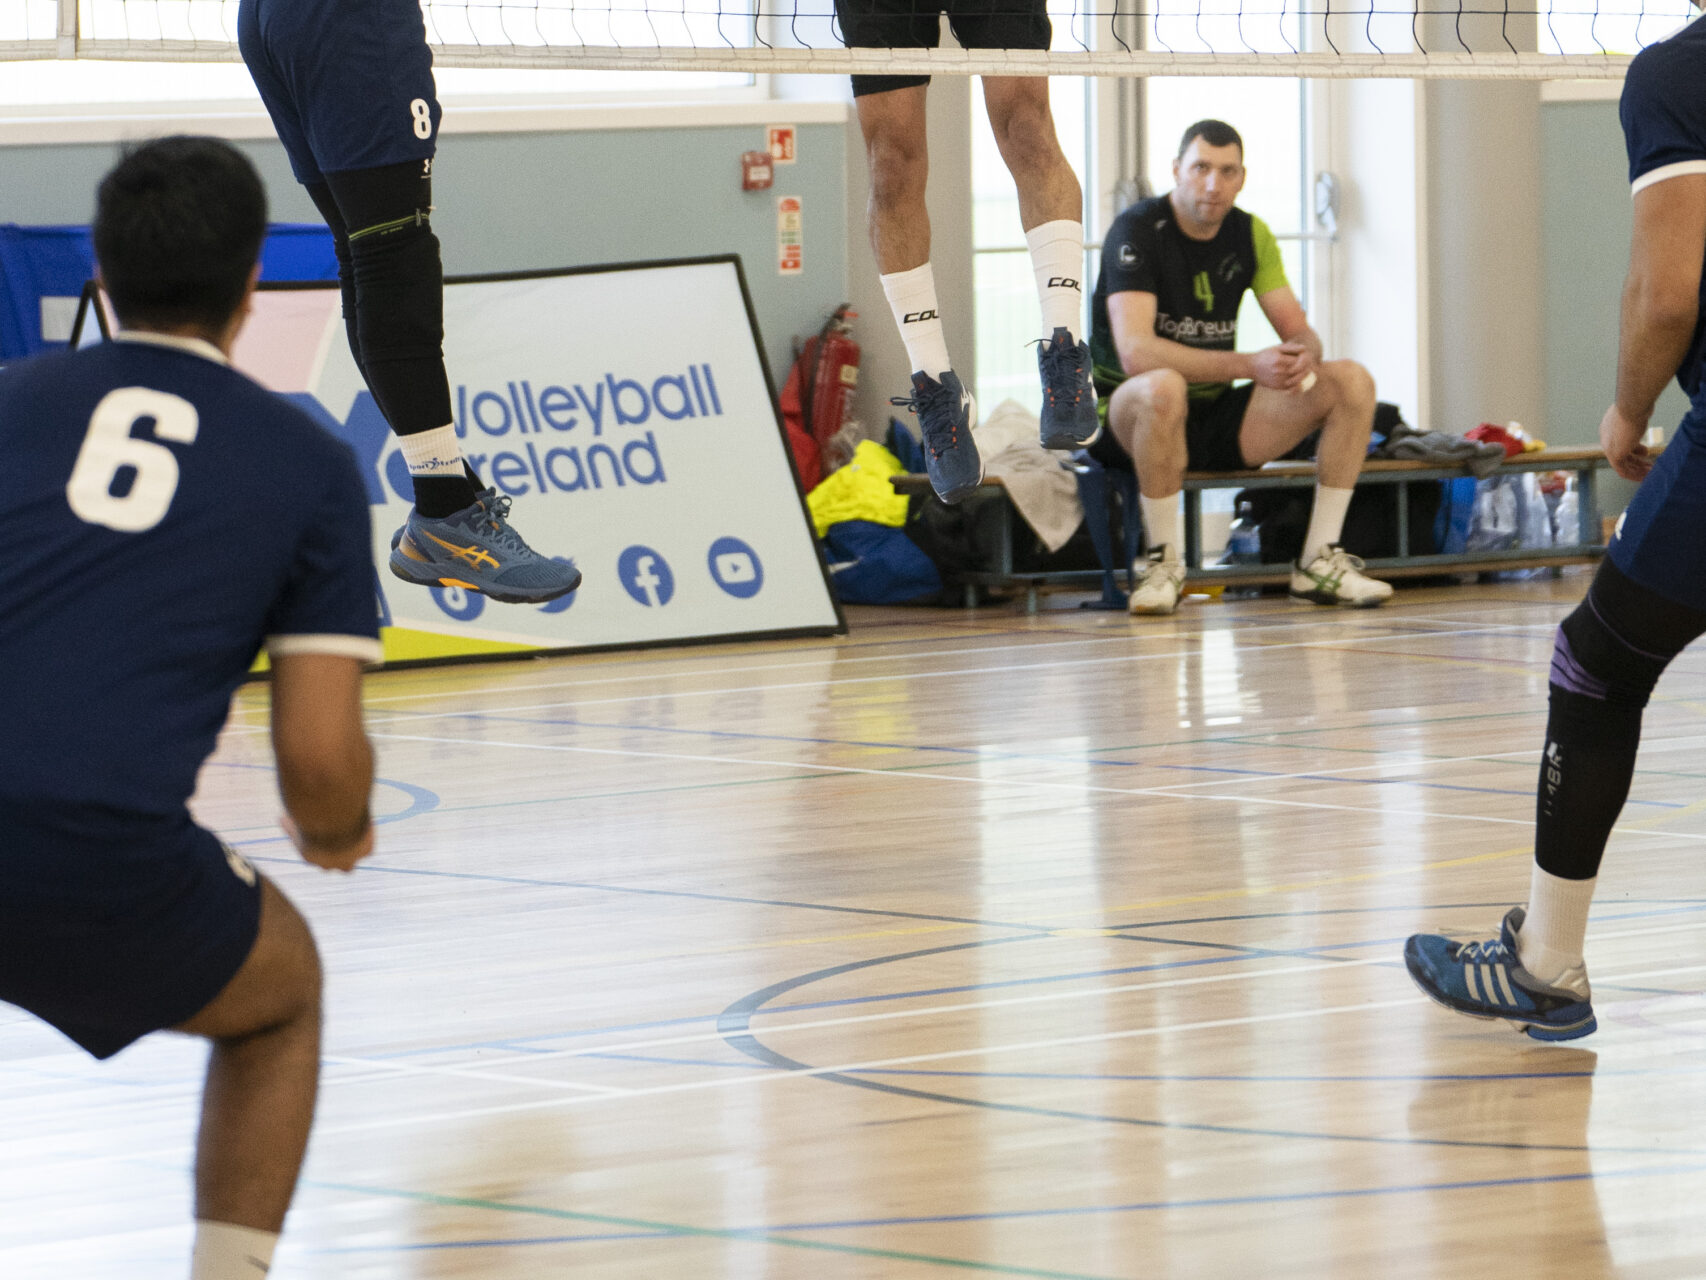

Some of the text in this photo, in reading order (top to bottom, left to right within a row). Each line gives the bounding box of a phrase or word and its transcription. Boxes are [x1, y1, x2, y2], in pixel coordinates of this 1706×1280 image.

[410, 98, 432, 140] 8
[1193, 271, 1214, 312] 4
[65, 386, 200, 534] 6
[467, 431, 667, 497] reland
